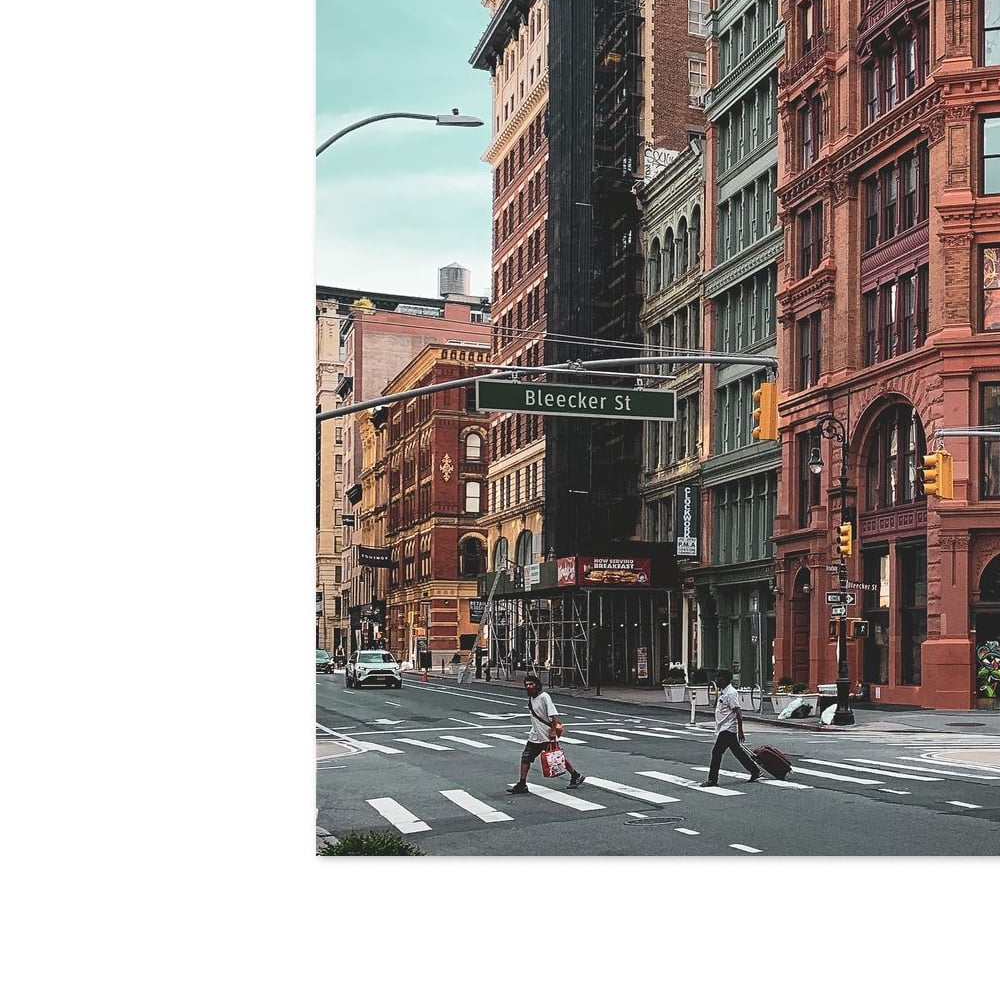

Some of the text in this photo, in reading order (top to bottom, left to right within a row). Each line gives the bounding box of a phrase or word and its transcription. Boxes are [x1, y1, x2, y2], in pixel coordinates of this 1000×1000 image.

[525, 389, 631, 411] Bleecker St
[683, 487, 692, 539] CLOCKWORK
